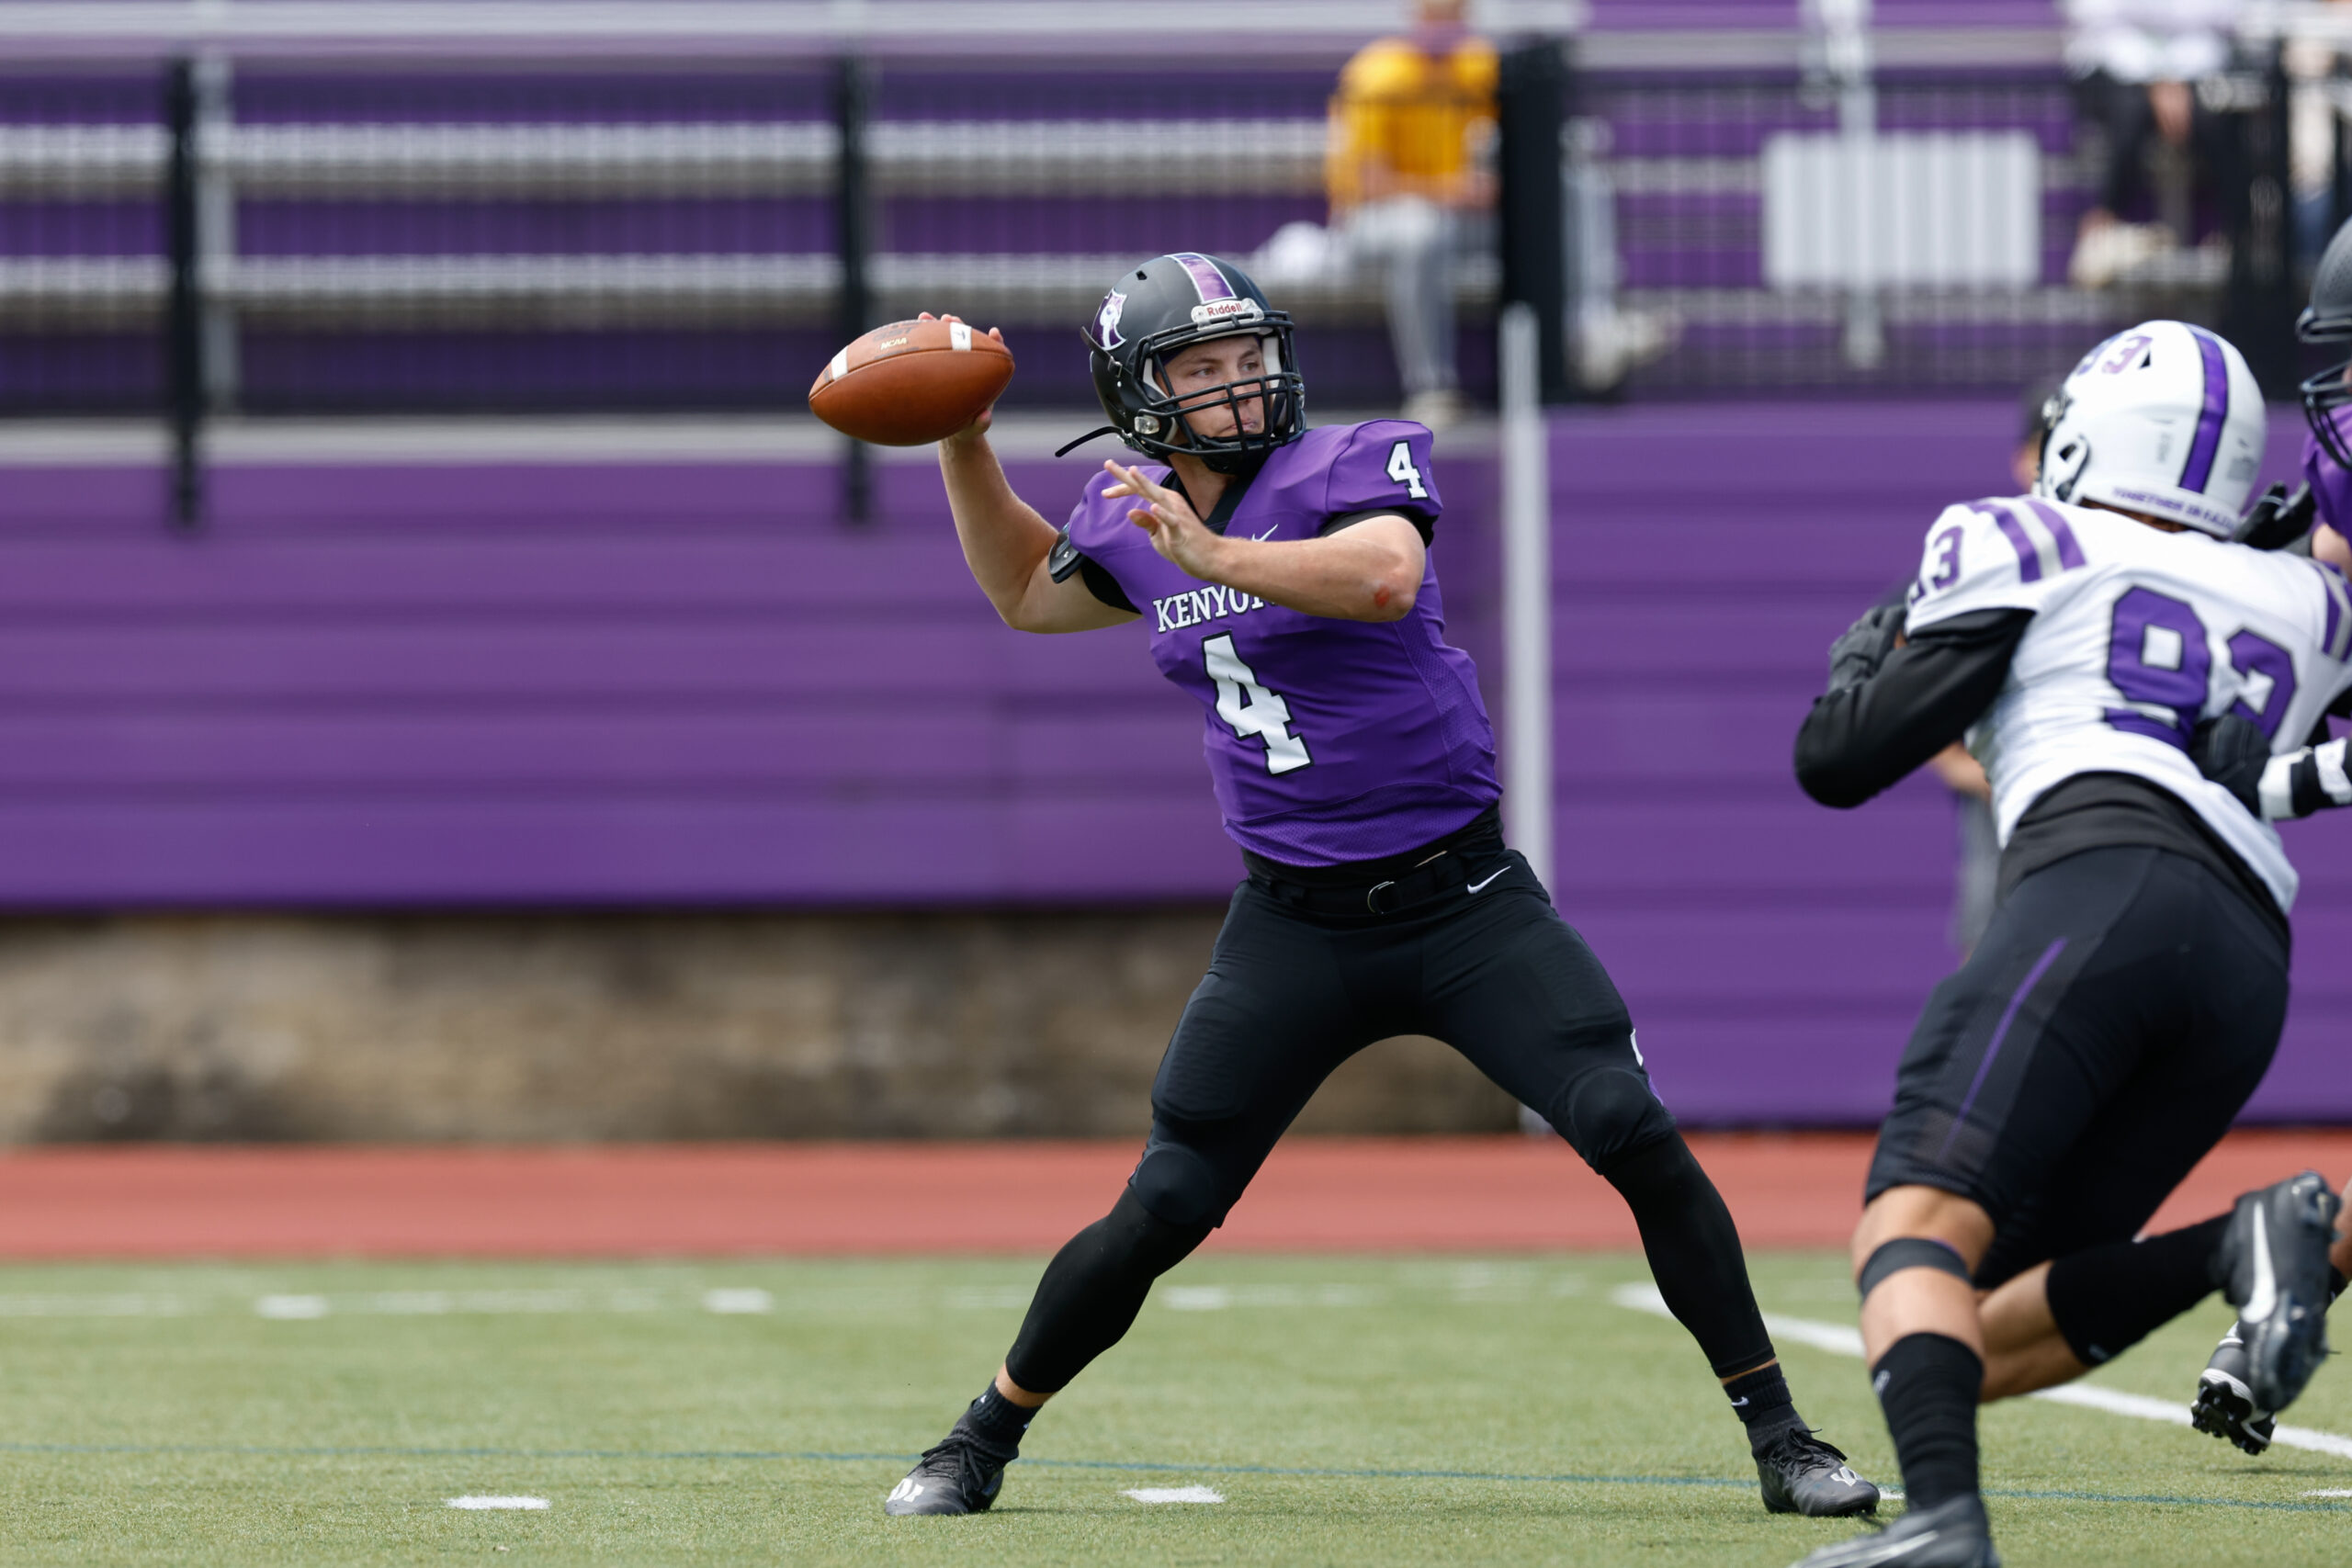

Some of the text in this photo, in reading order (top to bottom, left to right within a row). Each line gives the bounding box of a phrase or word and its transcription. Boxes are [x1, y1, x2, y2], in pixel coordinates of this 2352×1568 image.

[1206, 303, 1242, 316] Riddell
[879, 337, 909, 351] NCAA
[1385, 440, 1430, 501] 4
[1201, 629, 1315, 776] 4
